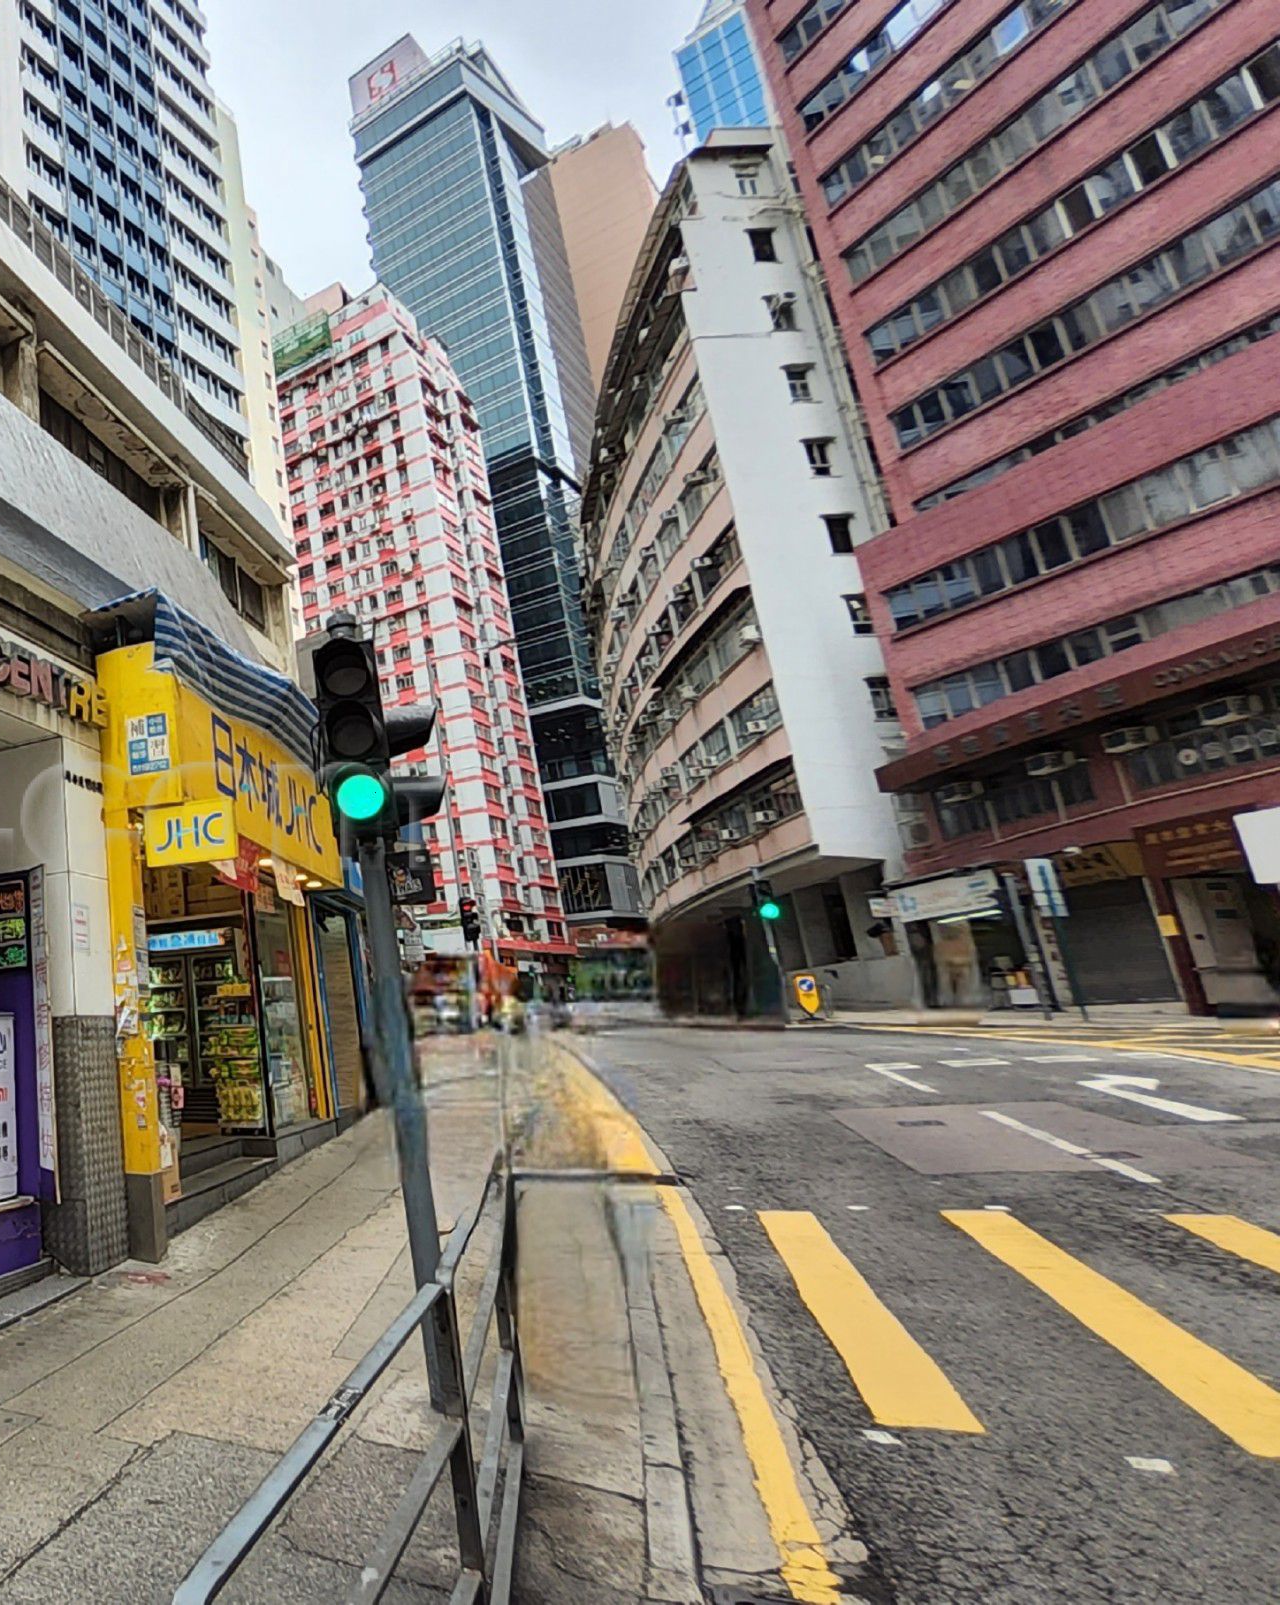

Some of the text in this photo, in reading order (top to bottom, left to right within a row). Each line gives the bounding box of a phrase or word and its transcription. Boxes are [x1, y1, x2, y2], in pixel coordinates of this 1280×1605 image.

[211, 711, 324, 856] 日本城 JHC
[155, 812, 226, 853] JHC
